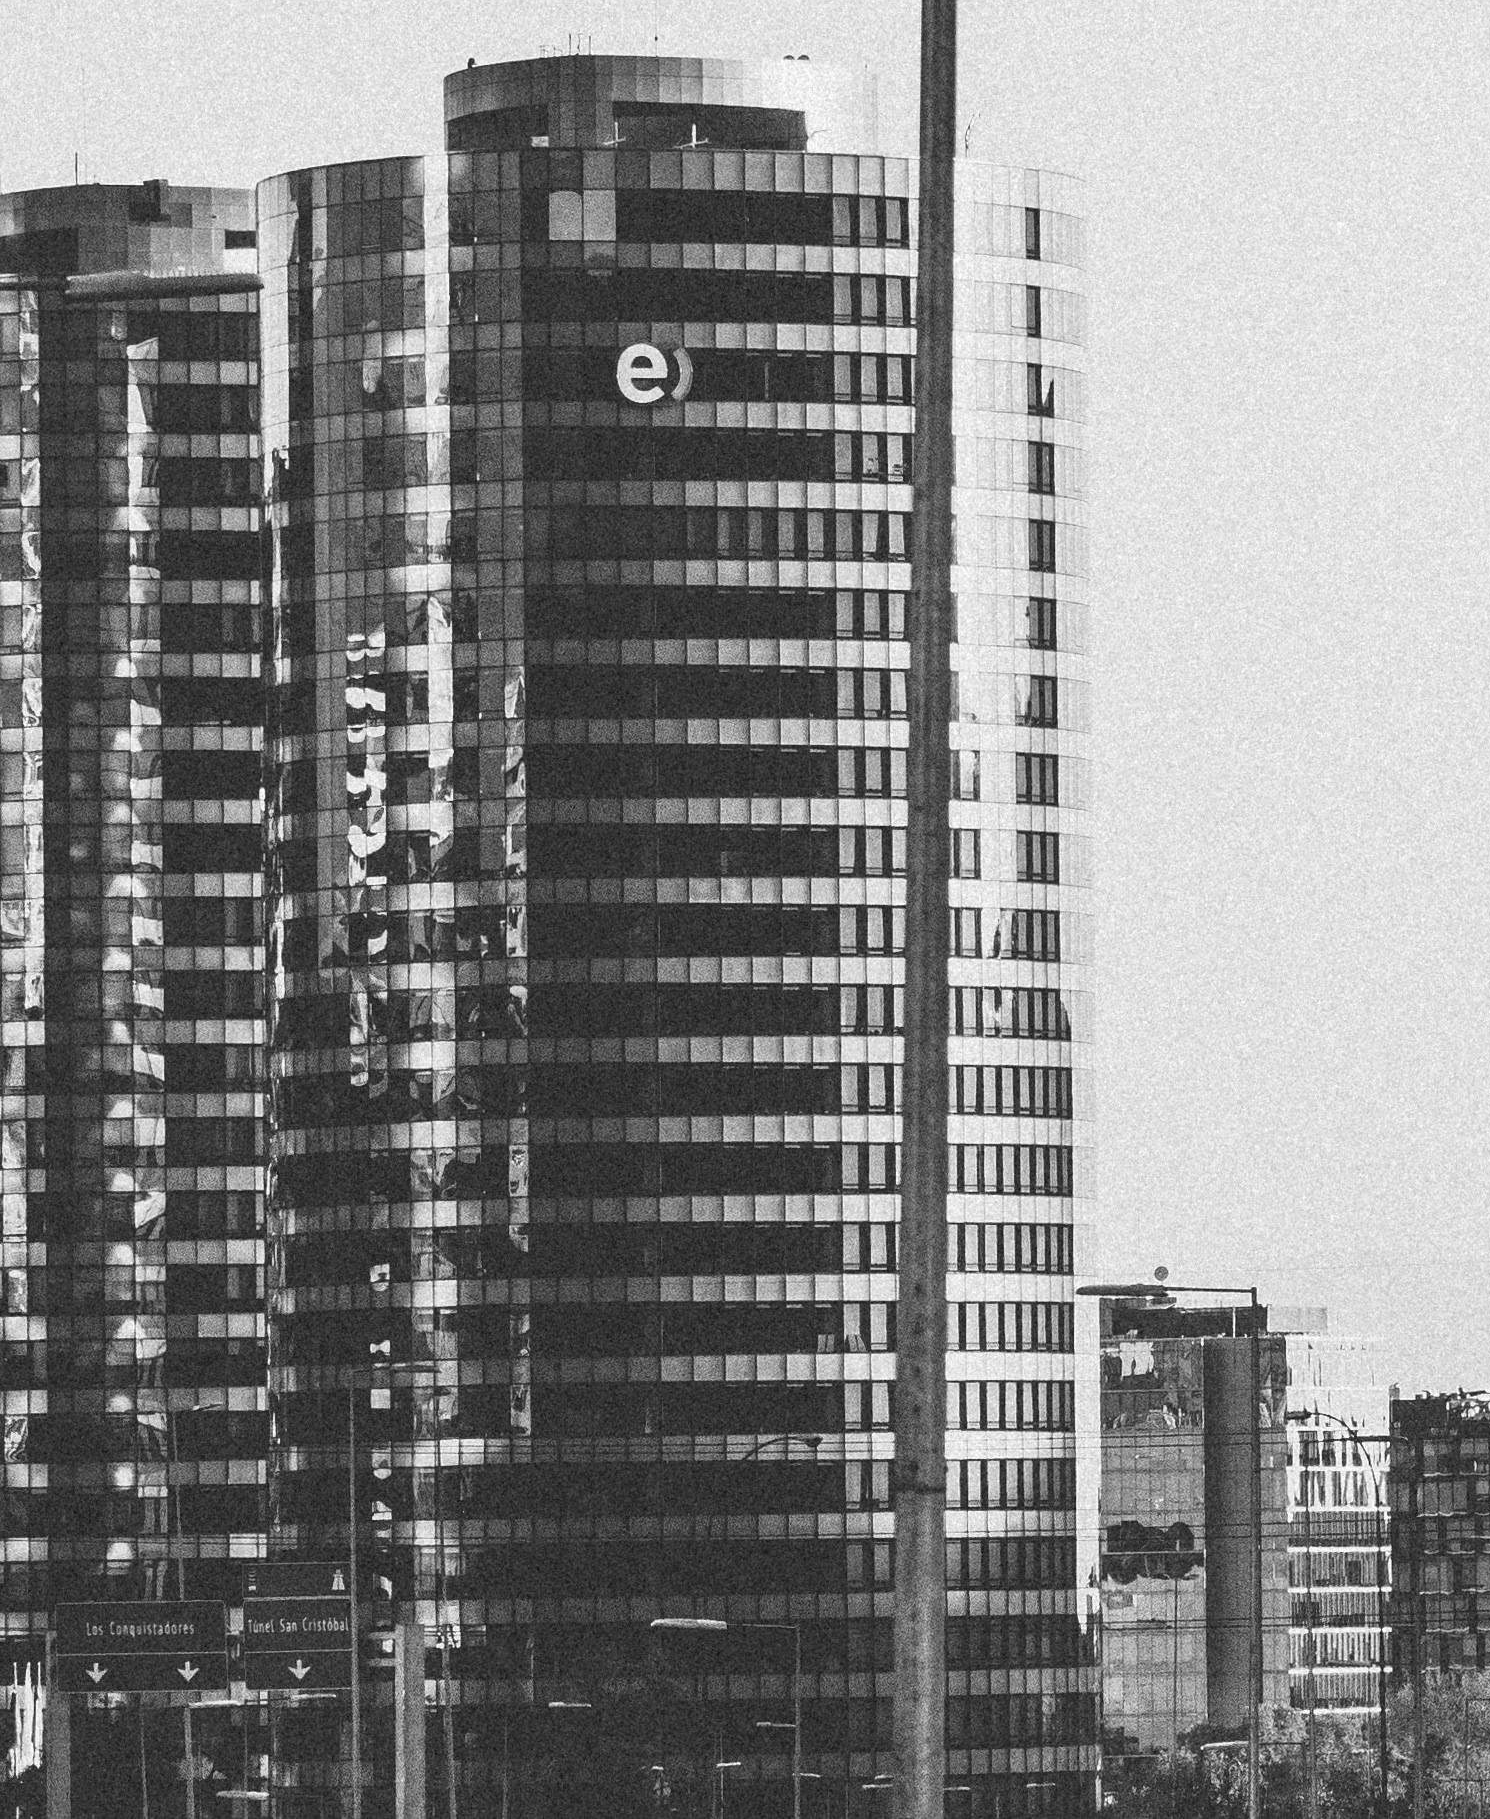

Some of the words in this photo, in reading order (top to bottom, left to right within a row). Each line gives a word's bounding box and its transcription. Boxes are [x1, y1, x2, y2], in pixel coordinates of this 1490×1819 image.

[87, 1622, 104, 1637] Los
[109, 1621, 195, 1638] Conquistadores
[247, 1618, 275, 1634] Túnel
[279, 1618, 298, 1633] San
[302, 1616, 350, 1632] Cristóbal
